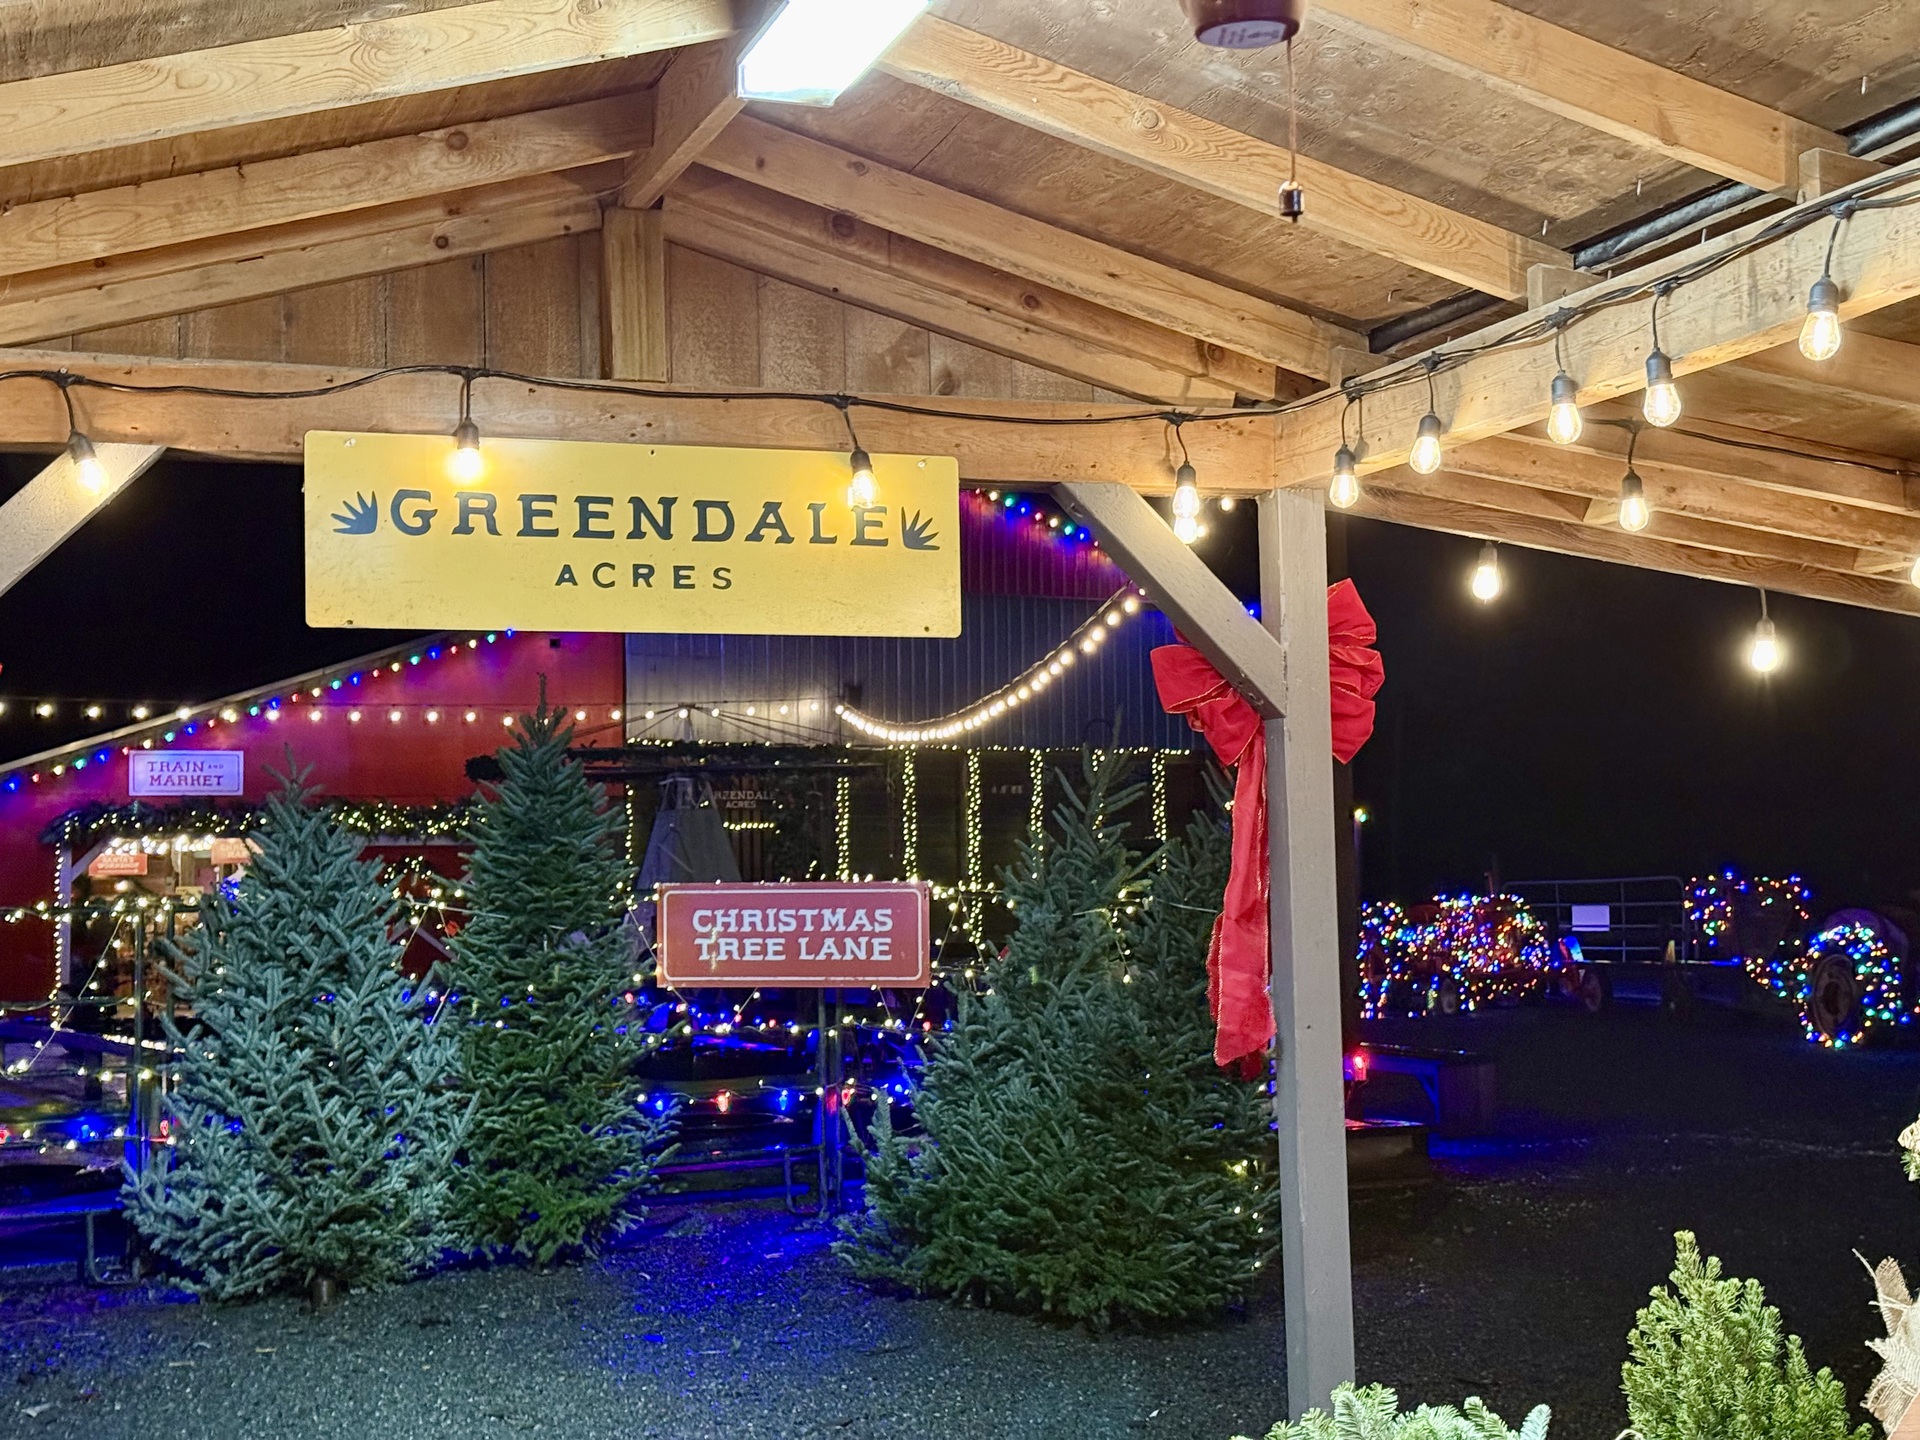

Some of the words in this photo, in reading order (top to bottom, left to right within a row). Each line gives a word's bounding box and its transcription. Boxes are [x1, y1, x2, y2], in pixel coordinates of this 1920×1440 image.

[390, 488, 888, 547] GREENDALE
[555, 562, 732, 589] ACRES
[147, 760, 205, 773] TRAIN
[149, 774, 224, 787] MARKET
[725, 801, 756, 809] ACRES
[692, 908, 893, 933] CHRISTMAS
[694, 937, 786, 961] TREE
[798, 937, 893, 961] LANE
